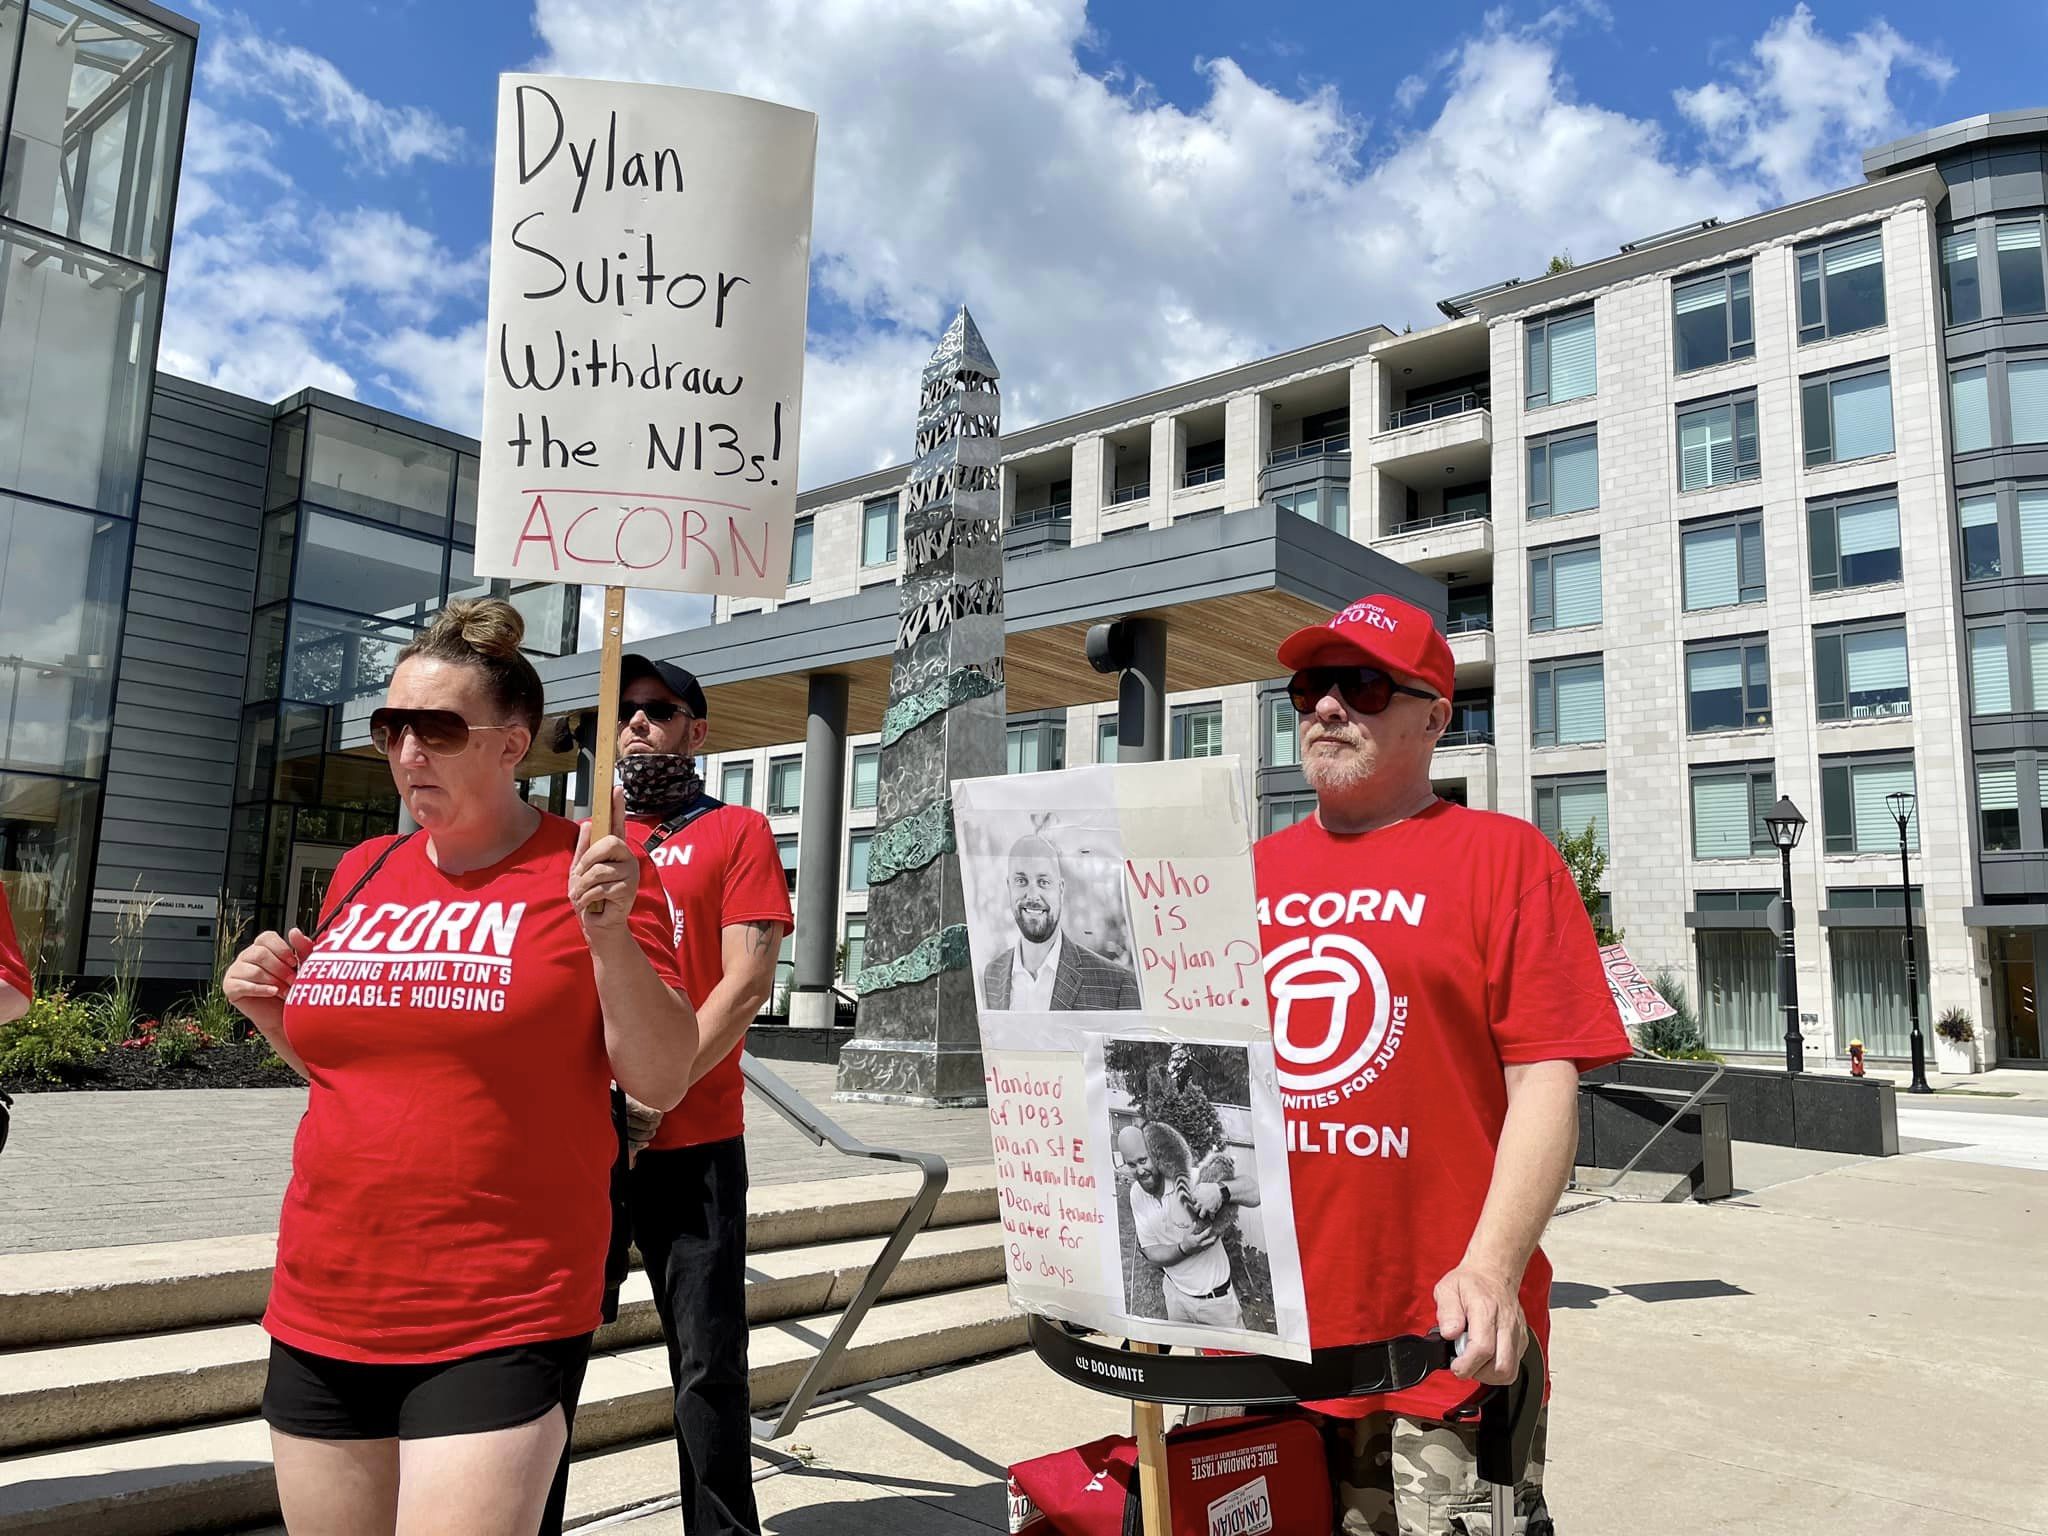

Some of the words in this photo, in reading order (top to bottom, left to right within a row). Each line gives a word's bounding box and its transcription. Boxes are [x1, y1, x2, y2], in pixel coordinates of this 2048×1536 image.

[517, 85, 684, 213] Dylan
[511, 211, 751, 328] Suitor
[500, 323, 744, 396] Withdraw
[507, 412, 600, 469] the
[511, 495, 769, 579] ACORN
[1126, 859, 1210, 899] Who
[313, 900, 527, 957] ACORN
[673, 908, 685, 949] STICE
[1154, 904, 1187, 936] is
[388, 961, 512, 985] HAMILTON'S
[1142, 941, 1215, 984] Dylan
[1600, 945, 1667, 1014] HOMES
[410, 985, 505, 1012] HOUSING
[1282, 1089, 1339, 1109] NITIES
[1341, 1067, 1380, 1099] FOR
[1374, 995, 1409, 1071] JUSTICE
[990, 1099, 1010, 1126] of
[1019, 1104, 1064, 1128] 1083
[1073, 1137, 1085, 1163] E
[1287, 1119, 1409, 1158] ILTON
[998, 1158, 1015, 1178] in
[1022, 1160, 1096, 1188] Hamilton
[1059, 1197, 1105, 1224] tenants
[1059, 1225, 1084, 1249] for
[1010, 1242, 1033, 1272] 86
[1040, 1254, 1074, 1288] days
[1091, 1359, 1145, 1383] DOLOMITE
[1191, 1460, 1216, 1480] TASTE
[1218, 1454, 1257, 1476] CANADIAN
[1258, 1450, 1278, 1467] TRUE
[1213, 1495, 1269, 1536] CANADIAN
